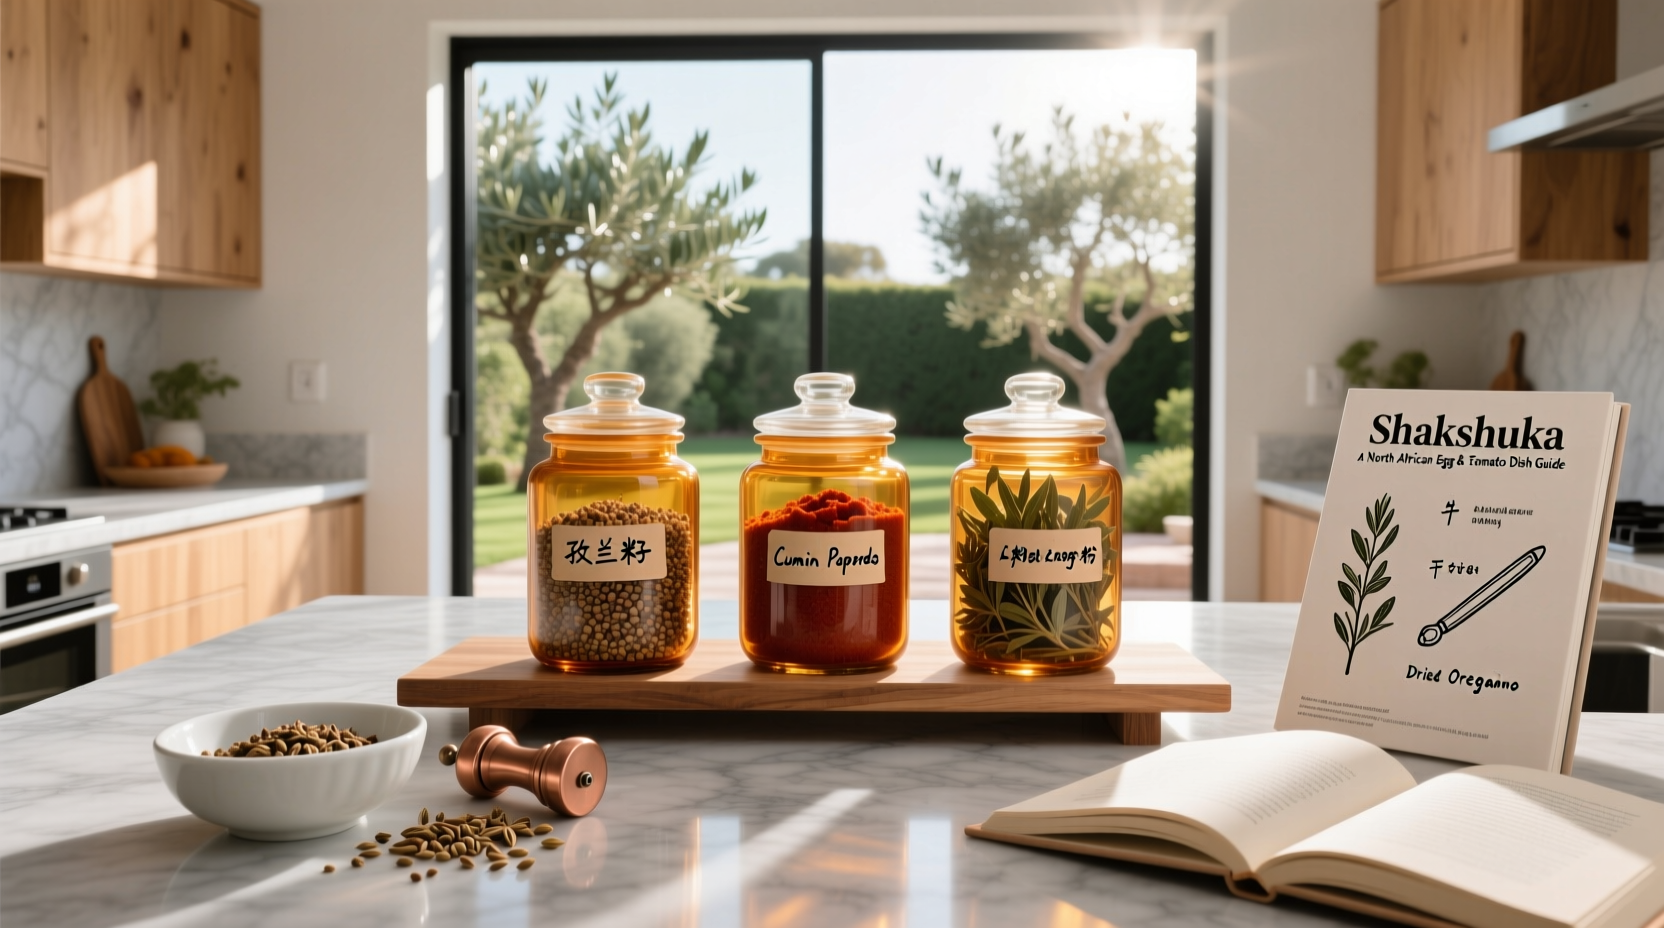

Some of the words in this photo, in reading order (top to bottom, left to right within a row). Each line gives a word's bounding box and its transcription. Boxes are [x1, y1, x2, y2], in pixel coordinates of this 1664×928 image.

[1369, 413, 1565, 450] Shakshuka
[1367, 451, 1394, 463] North
[1457, 454, 1464, 466] &
[1535, 457, 1566, 469] Guide
[774, 546, 819, 567] Cumin
[1406, 664, 1442, 682] Dried
